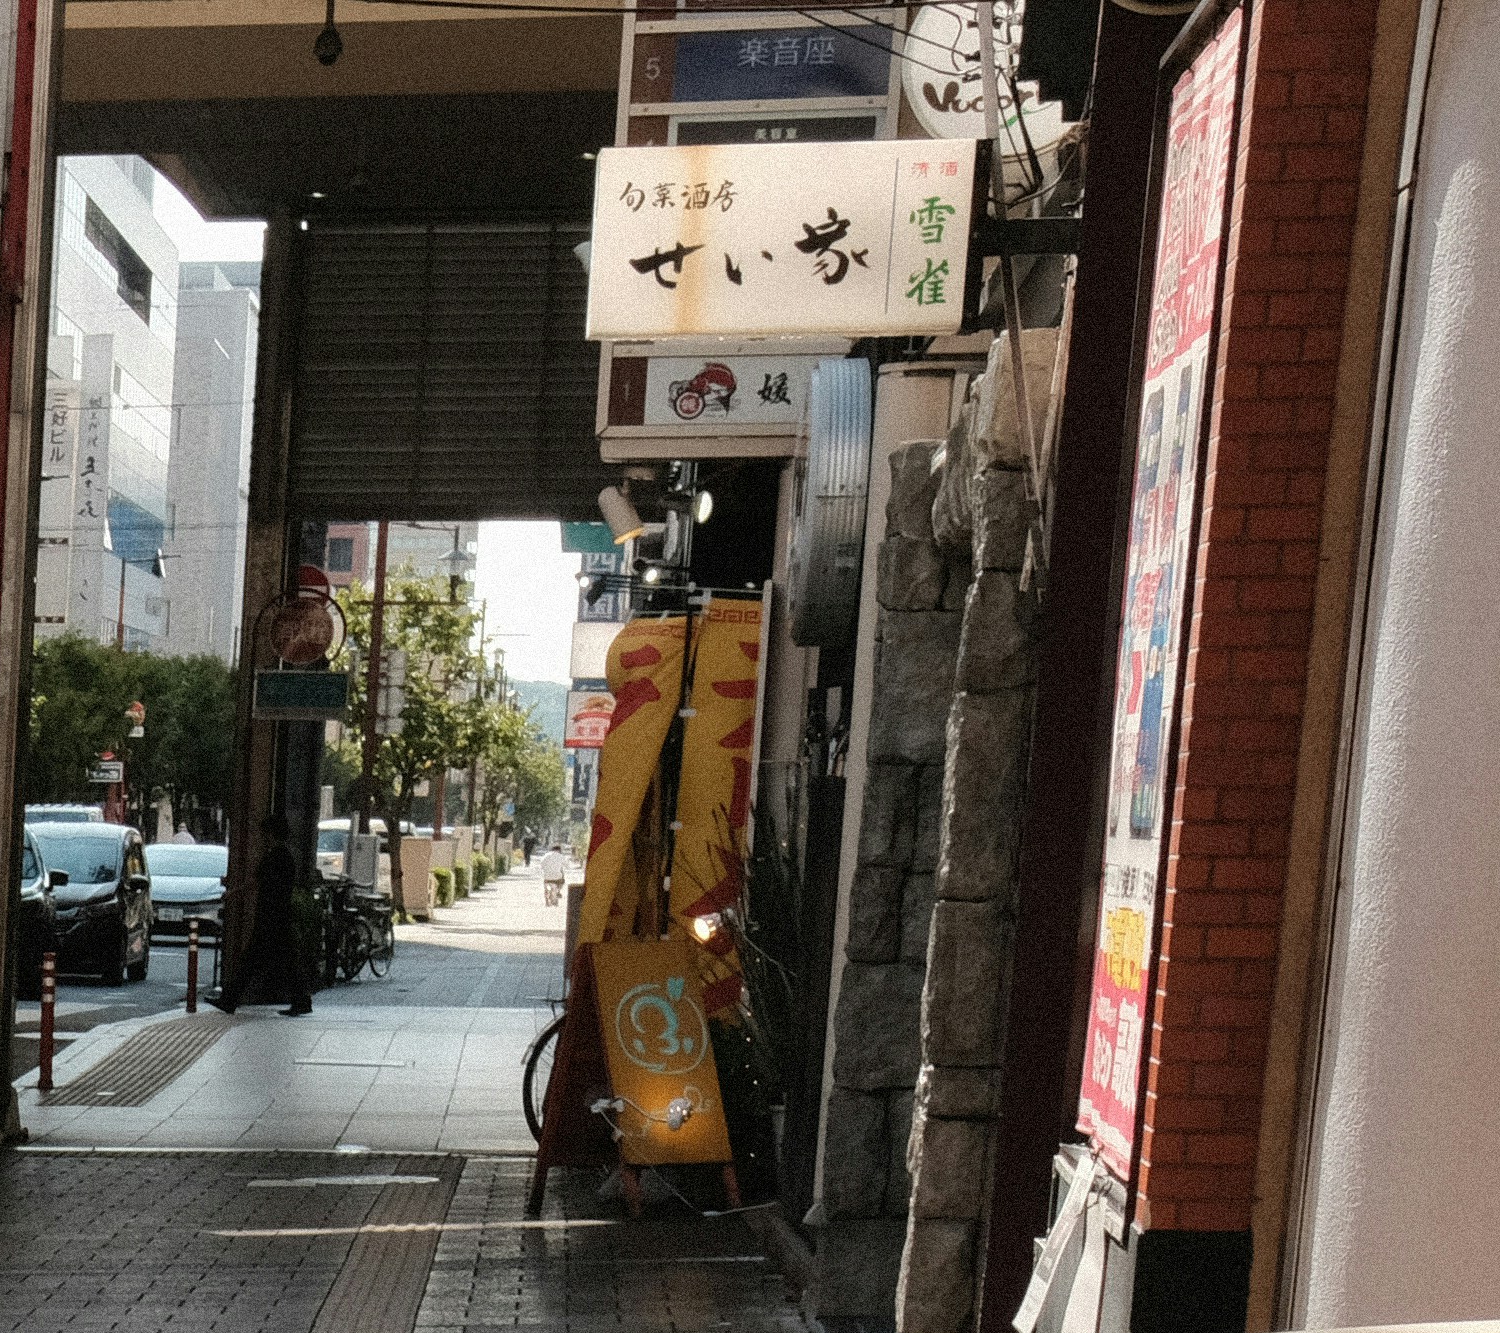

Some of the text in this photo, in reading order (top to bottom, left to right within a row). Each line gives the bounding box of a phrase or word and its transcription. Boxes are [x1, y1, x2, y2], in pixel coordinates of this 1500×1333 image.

[736, 34, 836, 69] 楽音座
[645, 55, 662, 83] 5
[910, 161, 959, 179] 清酒
[619, 180, 739, 213] 旬菜酒房
[629, 206, 871, 288] せい家
[905, 195, 957, 307] 雪雀
